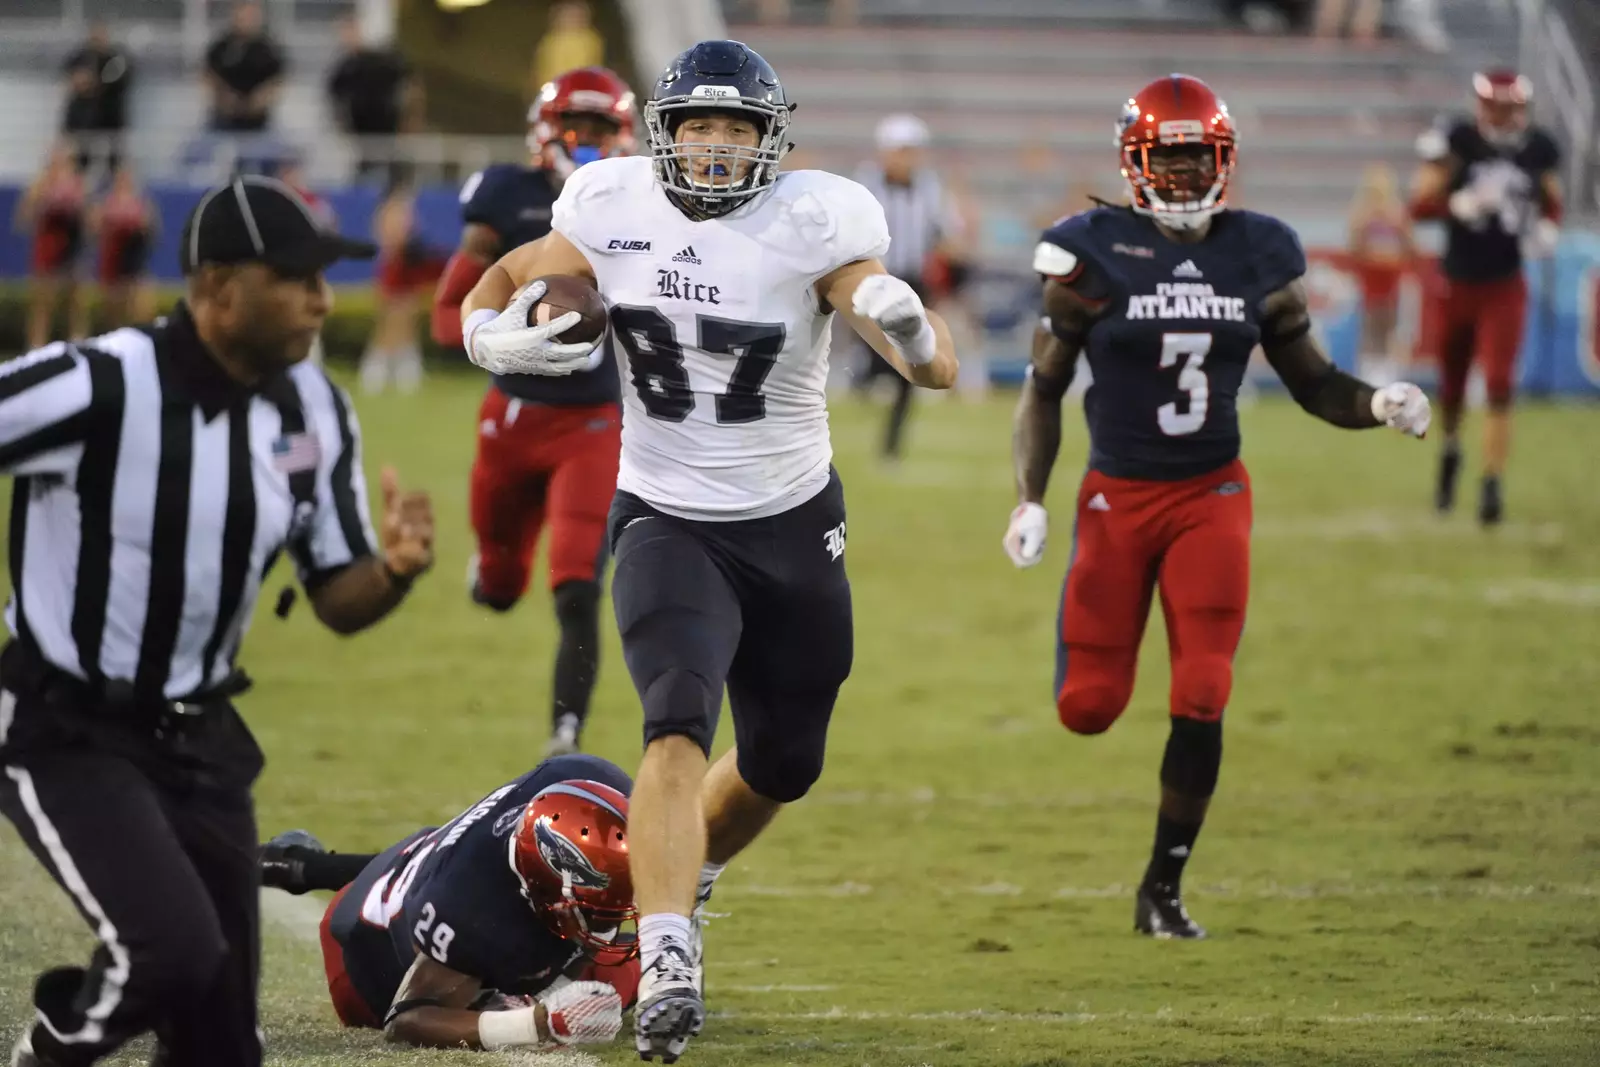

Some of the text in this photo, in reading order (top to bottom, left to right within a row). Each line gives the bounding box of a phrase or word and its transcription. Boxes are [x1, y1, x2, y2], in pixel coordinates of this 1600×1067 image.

[671, 255, 702, 265] adidas
[657, 268, 721, 305] Rice
[1125, 294, 1246, 322] ATLANTIC
[610, 303, 786, 423] 87
[1157, 331, 1213, 437] 3
[413, 901, 456, 964] 29
